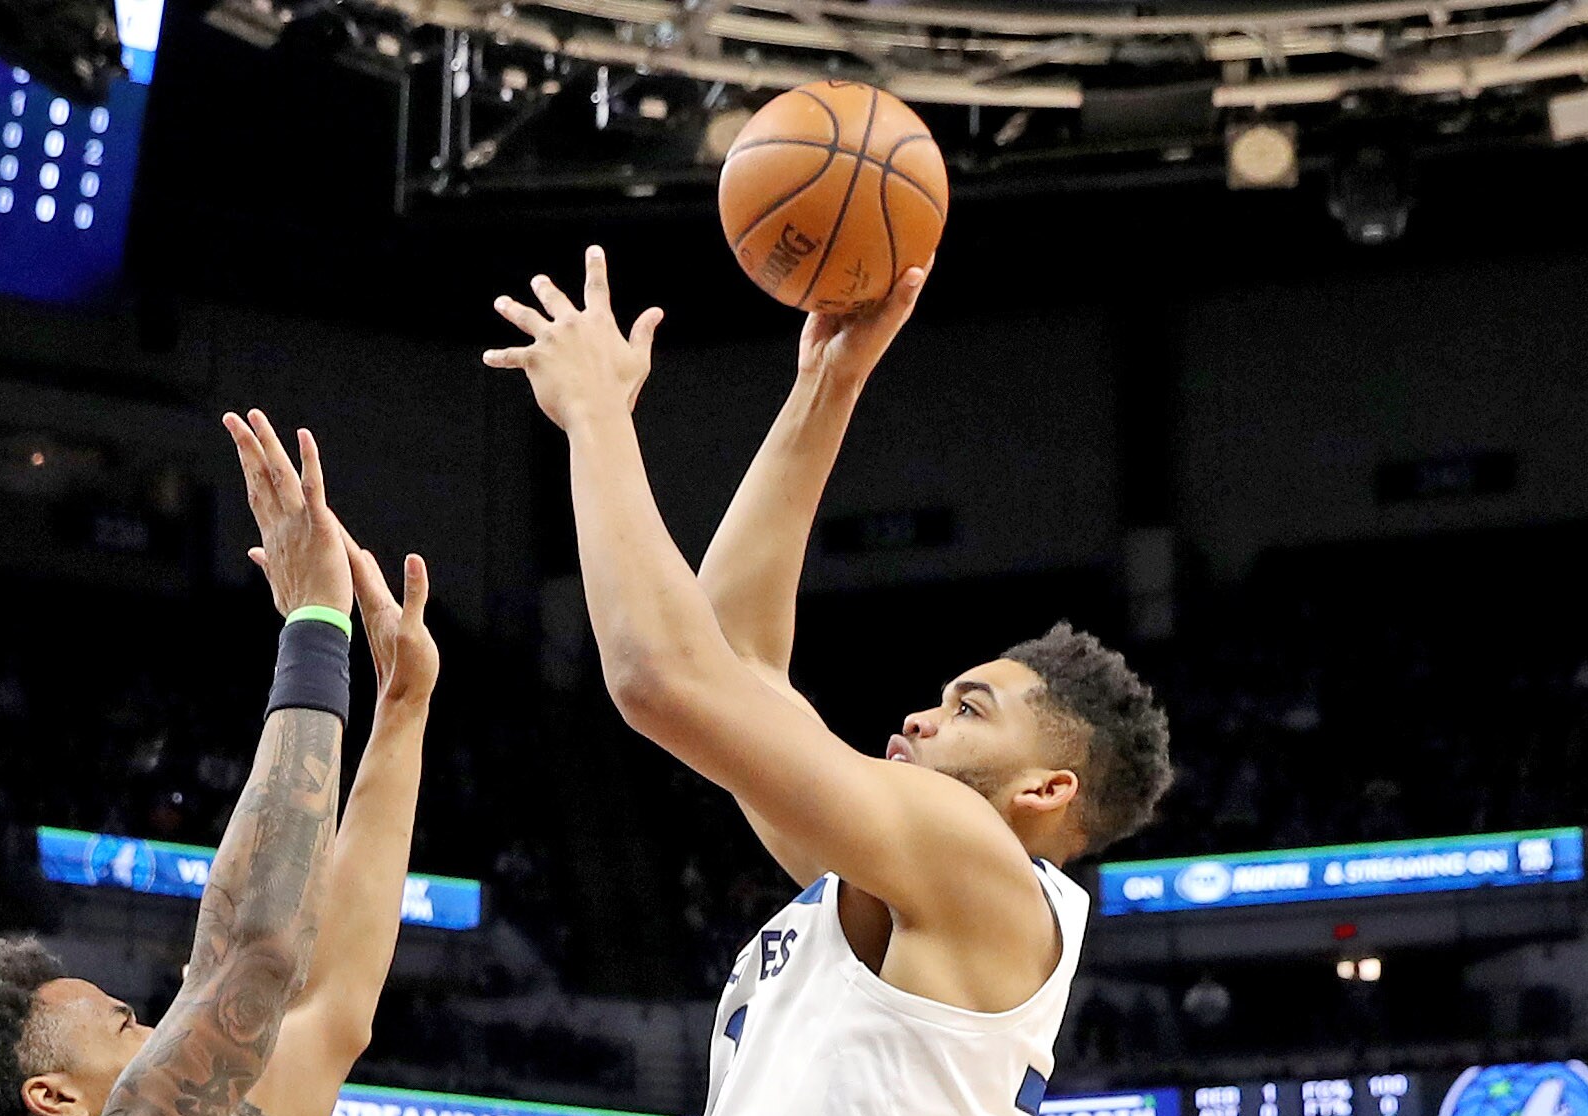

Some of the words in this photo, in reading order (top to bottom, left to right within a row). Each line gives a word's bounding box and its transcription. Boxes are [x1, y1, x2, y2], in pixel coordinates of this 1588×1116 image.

[49, 97, 70, 126] 0
[89, 106, 110, 134] 0
[2, 121, 23, 149] 0
[44, 130, 65, 158] 0
[83, 138, 104, 166] 2
[0, 154, 19, 181] 0
[39, 162, 60, 190] 0
[80, 171, 100, 198] 0
[35, 194, 56, 223] 0
[74, 202, 94, 230] 0
[1379, 1095, 1399, 1116] 0
